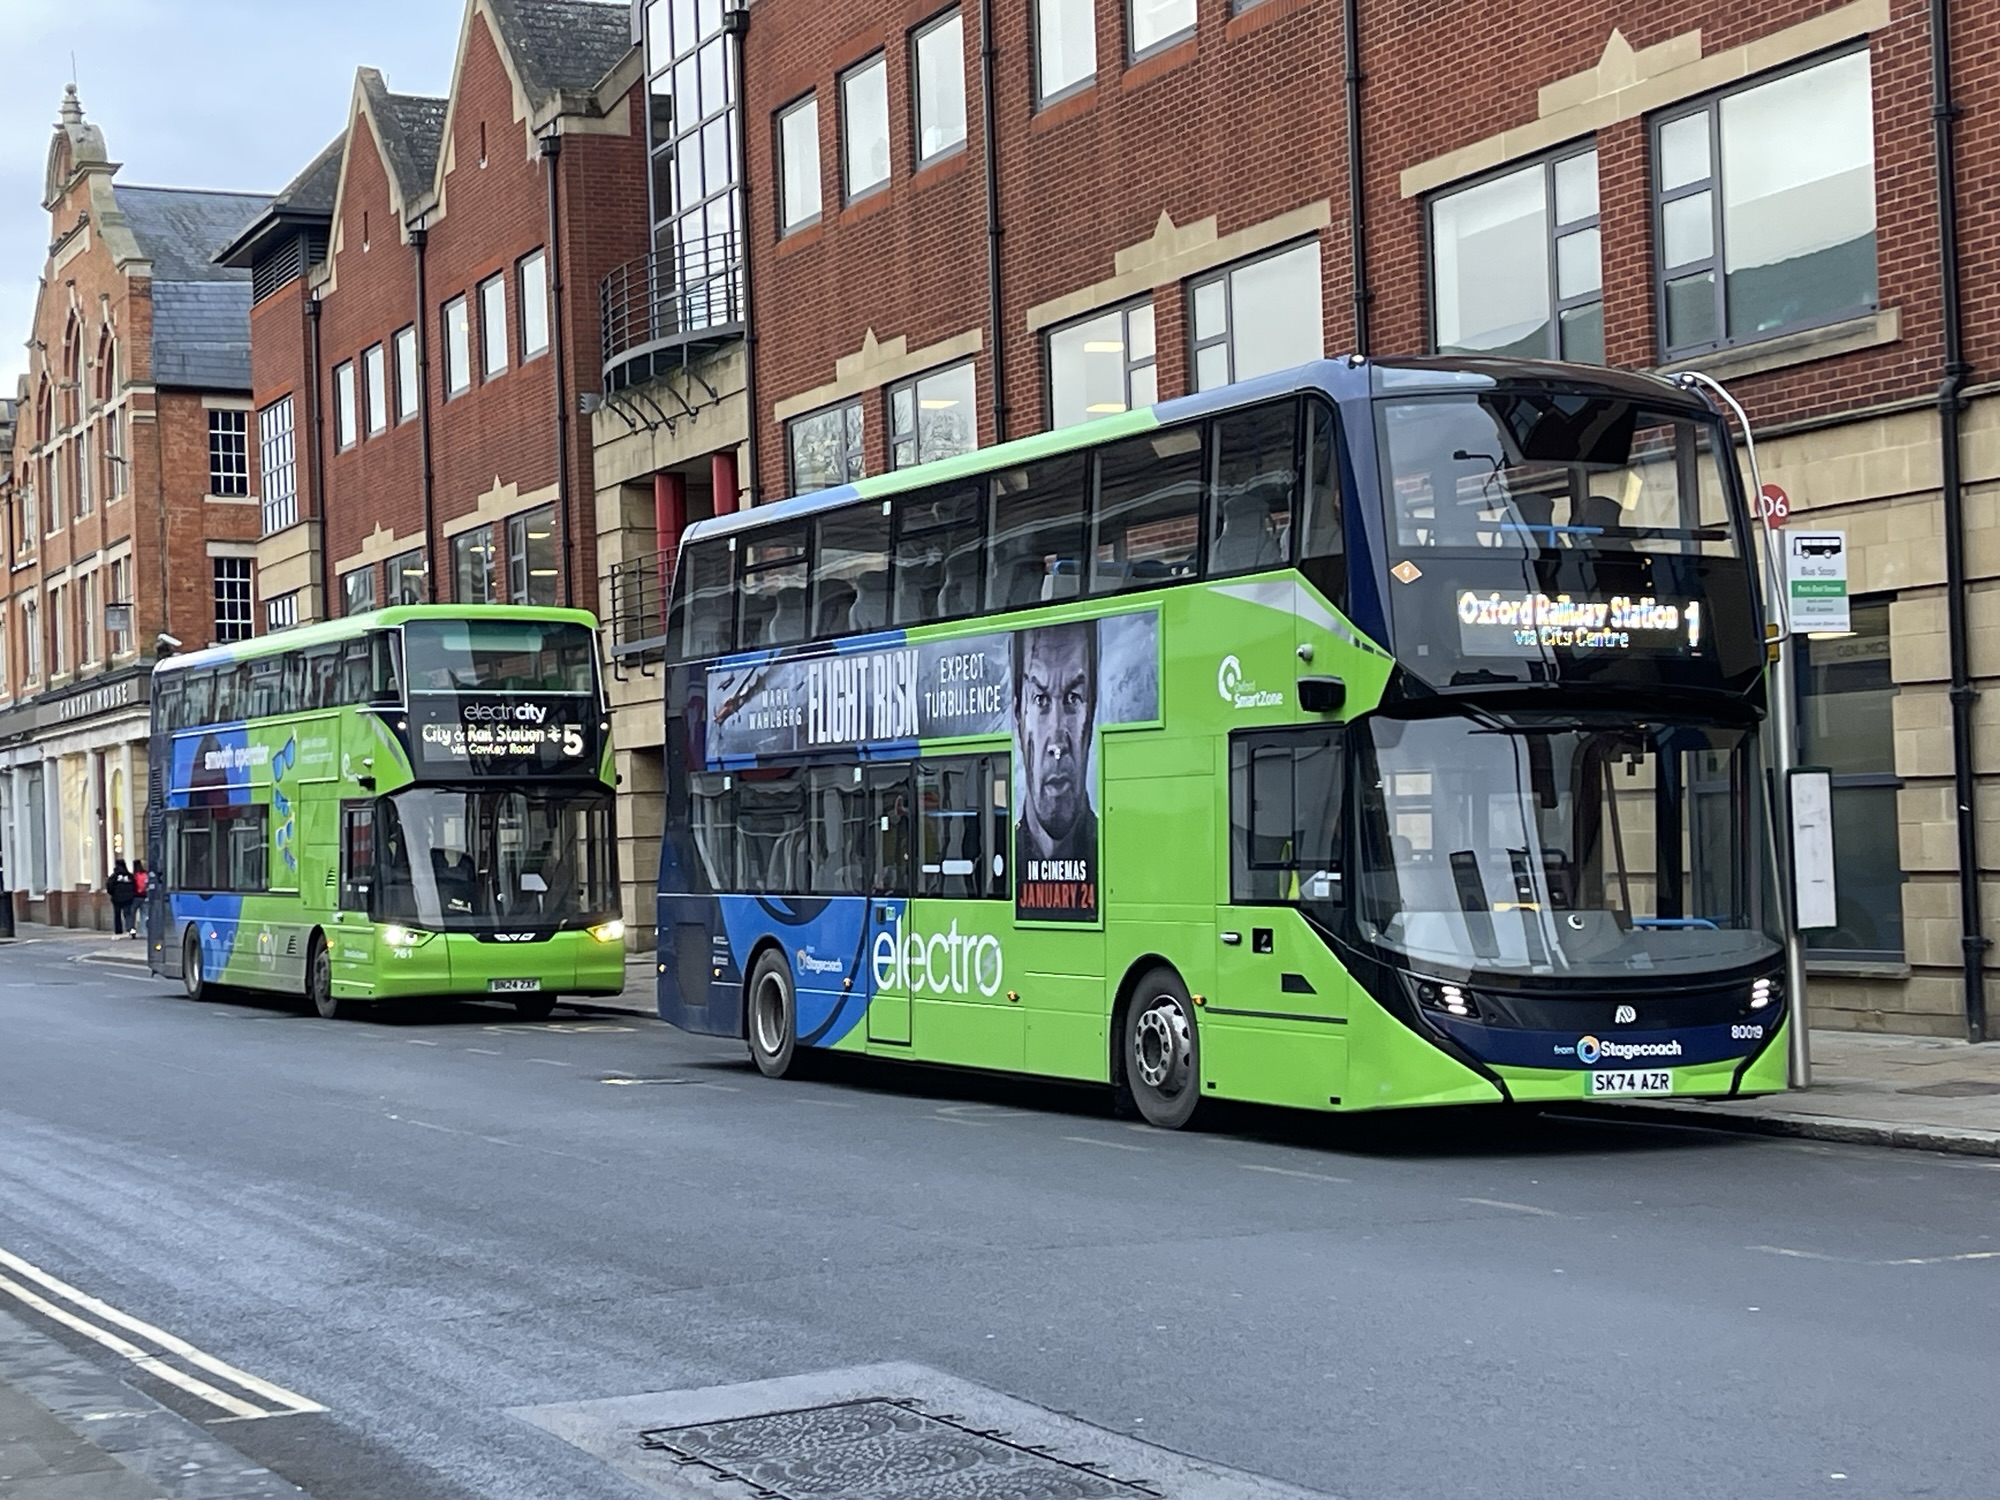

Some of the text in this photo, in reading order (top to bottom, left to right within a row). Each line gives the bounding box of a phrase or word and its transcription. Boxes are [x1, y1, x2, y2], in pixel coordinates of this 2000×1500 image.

[1459, 591, 1700, 647] Oxford Railway Station 1
[1514, 626, 1630, 649] via City Centre
[939, 653, 985, 684] EXPECT
[761, 687, 790, 708] MARK
[808, 650, 919, 745] FLIGHT RISK
[924, 685, 1001, 719] TURBULENCE
[1234, 691, 1283, 709] SmartZone
[749, 706, 803, 731] WAHLBERG
[422, 724, 584, 756] City & Rail Station 5
[450, 743, 536, 756] via Cowley Road
[1027, 860, 1087, 881] IN CINEMAS
[1019, 883, 1095, 909] JANUARY 24
[873, 914, 1003, 997] electro
[1731, 1025, 1764, 1039] 80019
[1553, 1040, 1682, 1060] from Stagecoach
[1595, 1073, 1670, 1091] SK74 AZR
